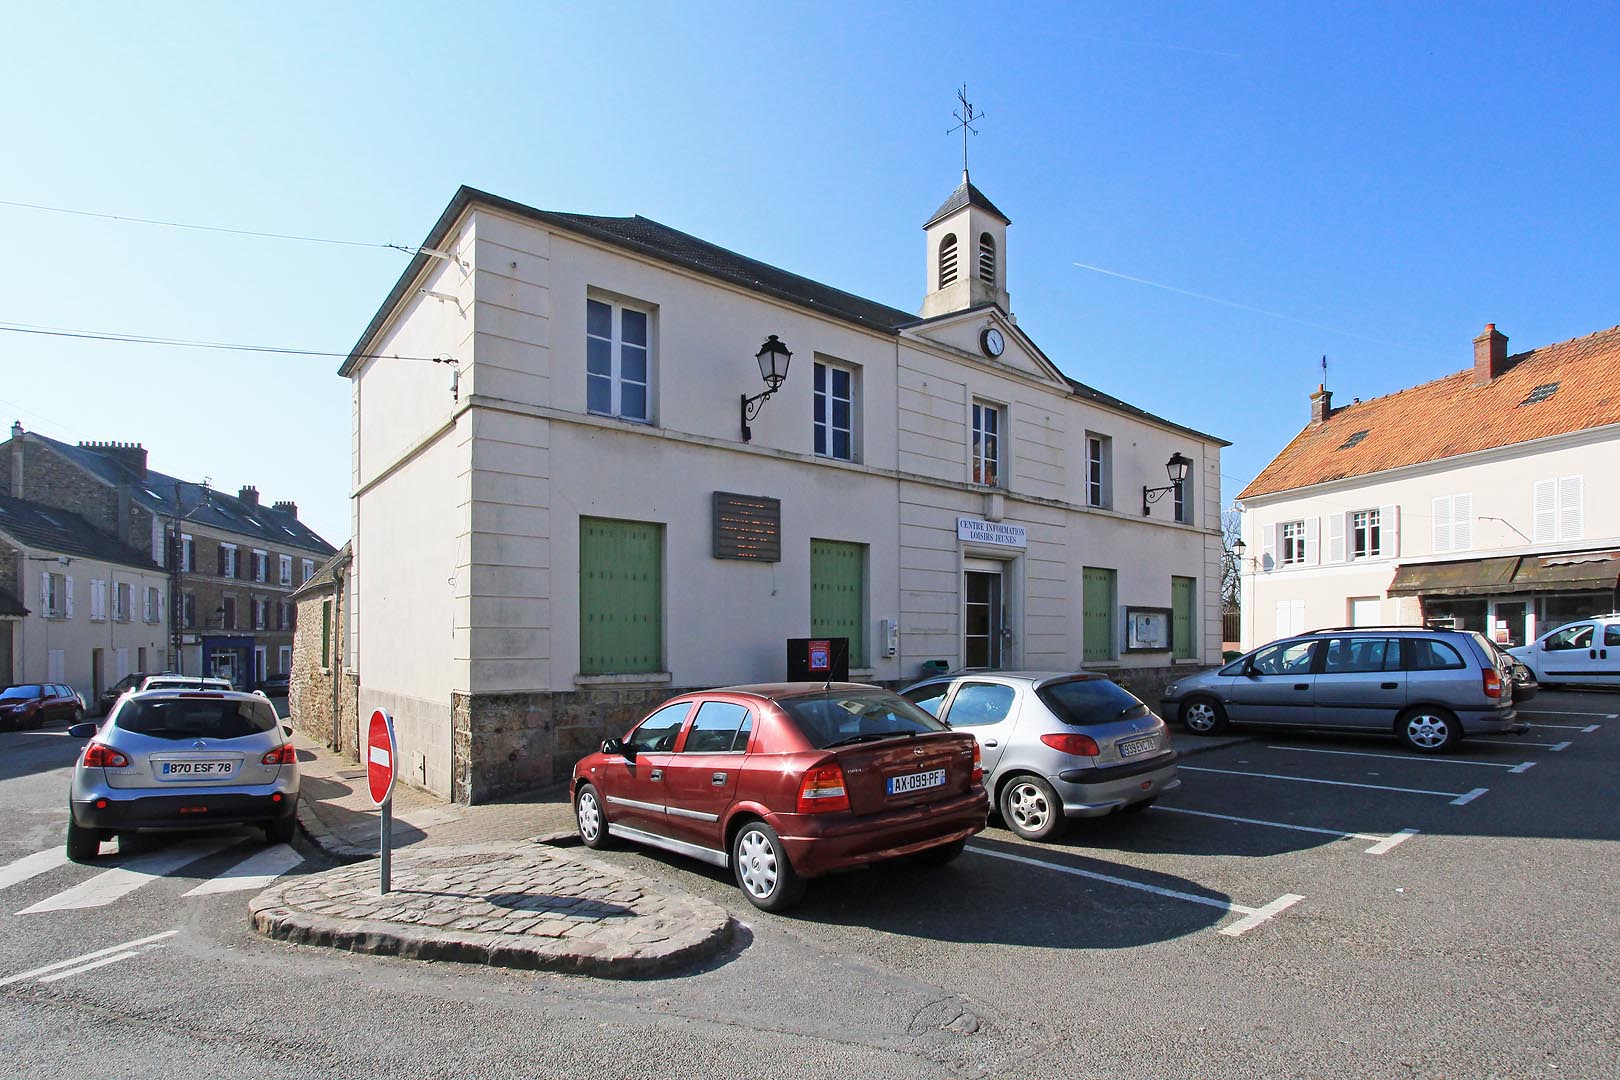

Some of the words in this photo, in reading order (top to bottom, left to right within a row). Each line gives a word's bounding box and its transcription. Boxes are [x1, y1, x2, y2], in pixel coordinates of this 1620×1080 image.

[960, 520, 985, 531] CENTRE
[986, 523, 1025, 536] INFORMATION
[970, 531, 994, 541] LOISIRS
[995, 534, 1017, 544] JEUNES
[170, 763, 192, 773] 870
[194, 763, 215, 773] ESF
[217, 763, 231, 773] 78
